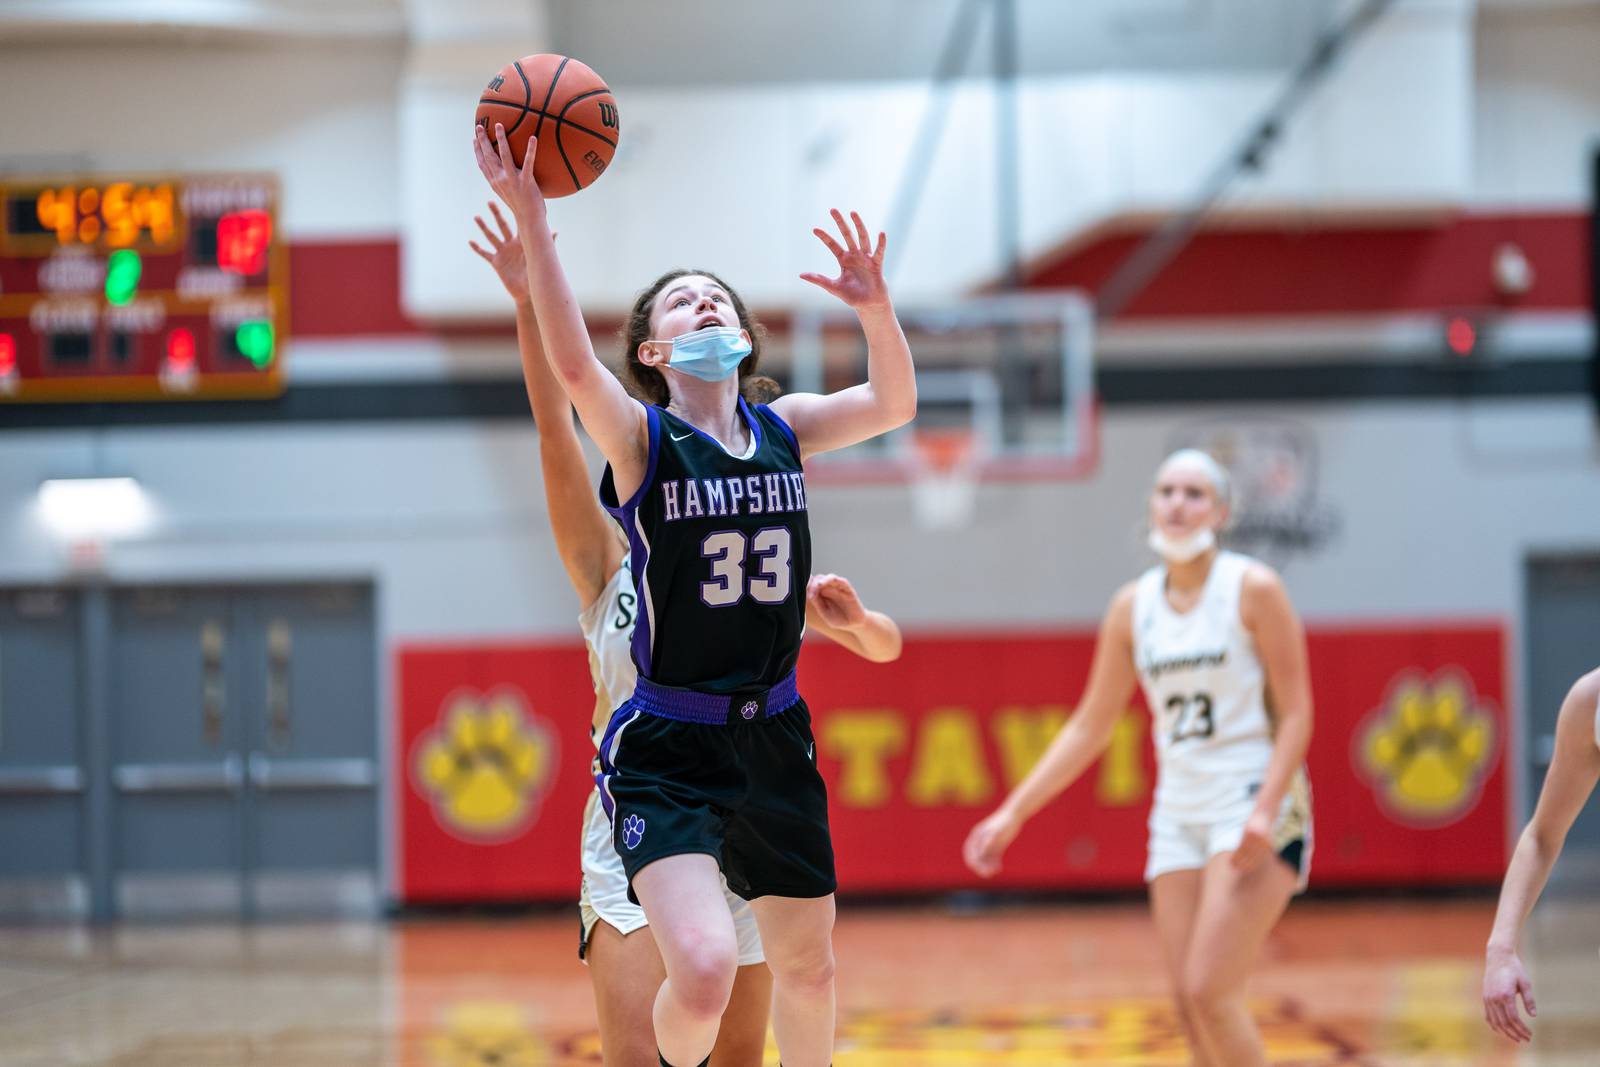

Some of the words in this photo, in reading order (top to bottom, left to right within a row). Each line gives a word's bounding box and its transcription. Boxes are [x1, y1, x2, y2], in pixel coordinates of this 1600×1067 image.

[661, 472, 807, 522] HAMPSHIR
[700, 525, 793, 608] 33
[1165, 691, 1215, 745] 23
